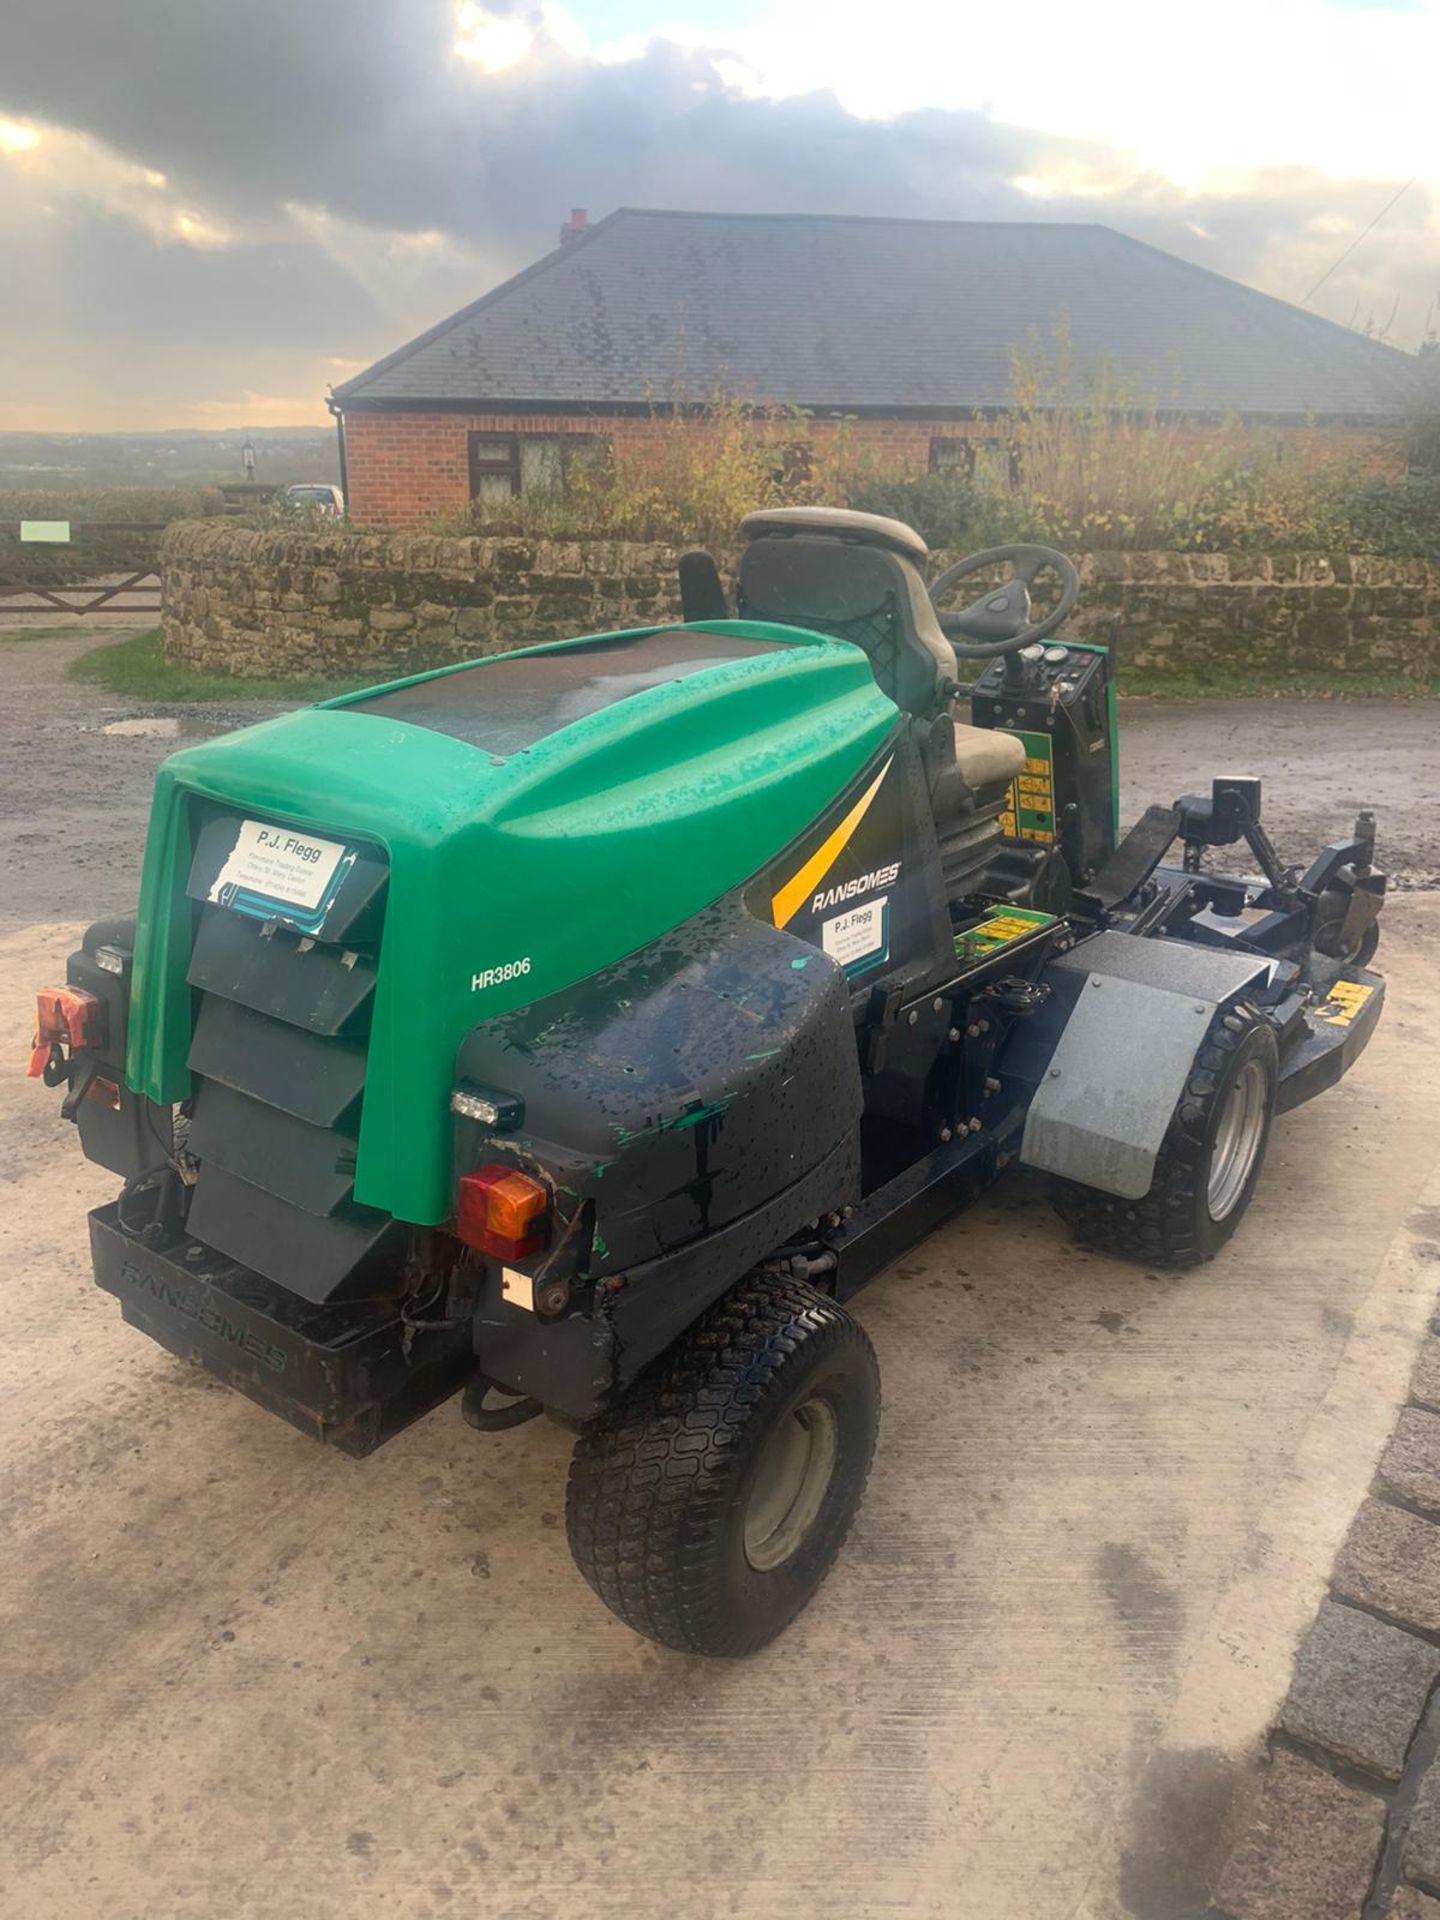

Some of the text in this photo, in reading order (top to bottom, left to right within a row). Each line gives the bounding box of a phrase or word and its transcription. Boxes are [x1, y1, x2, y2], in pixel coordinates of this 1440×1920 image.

[256, 831, 280, 849] P.J.
[283, 838, 322, 864] Flegg
[811, 861, 901, 914] RANSOMES
[851, 910, 873, 926] Flegg
[471, 957, 531, 992] HR3806
